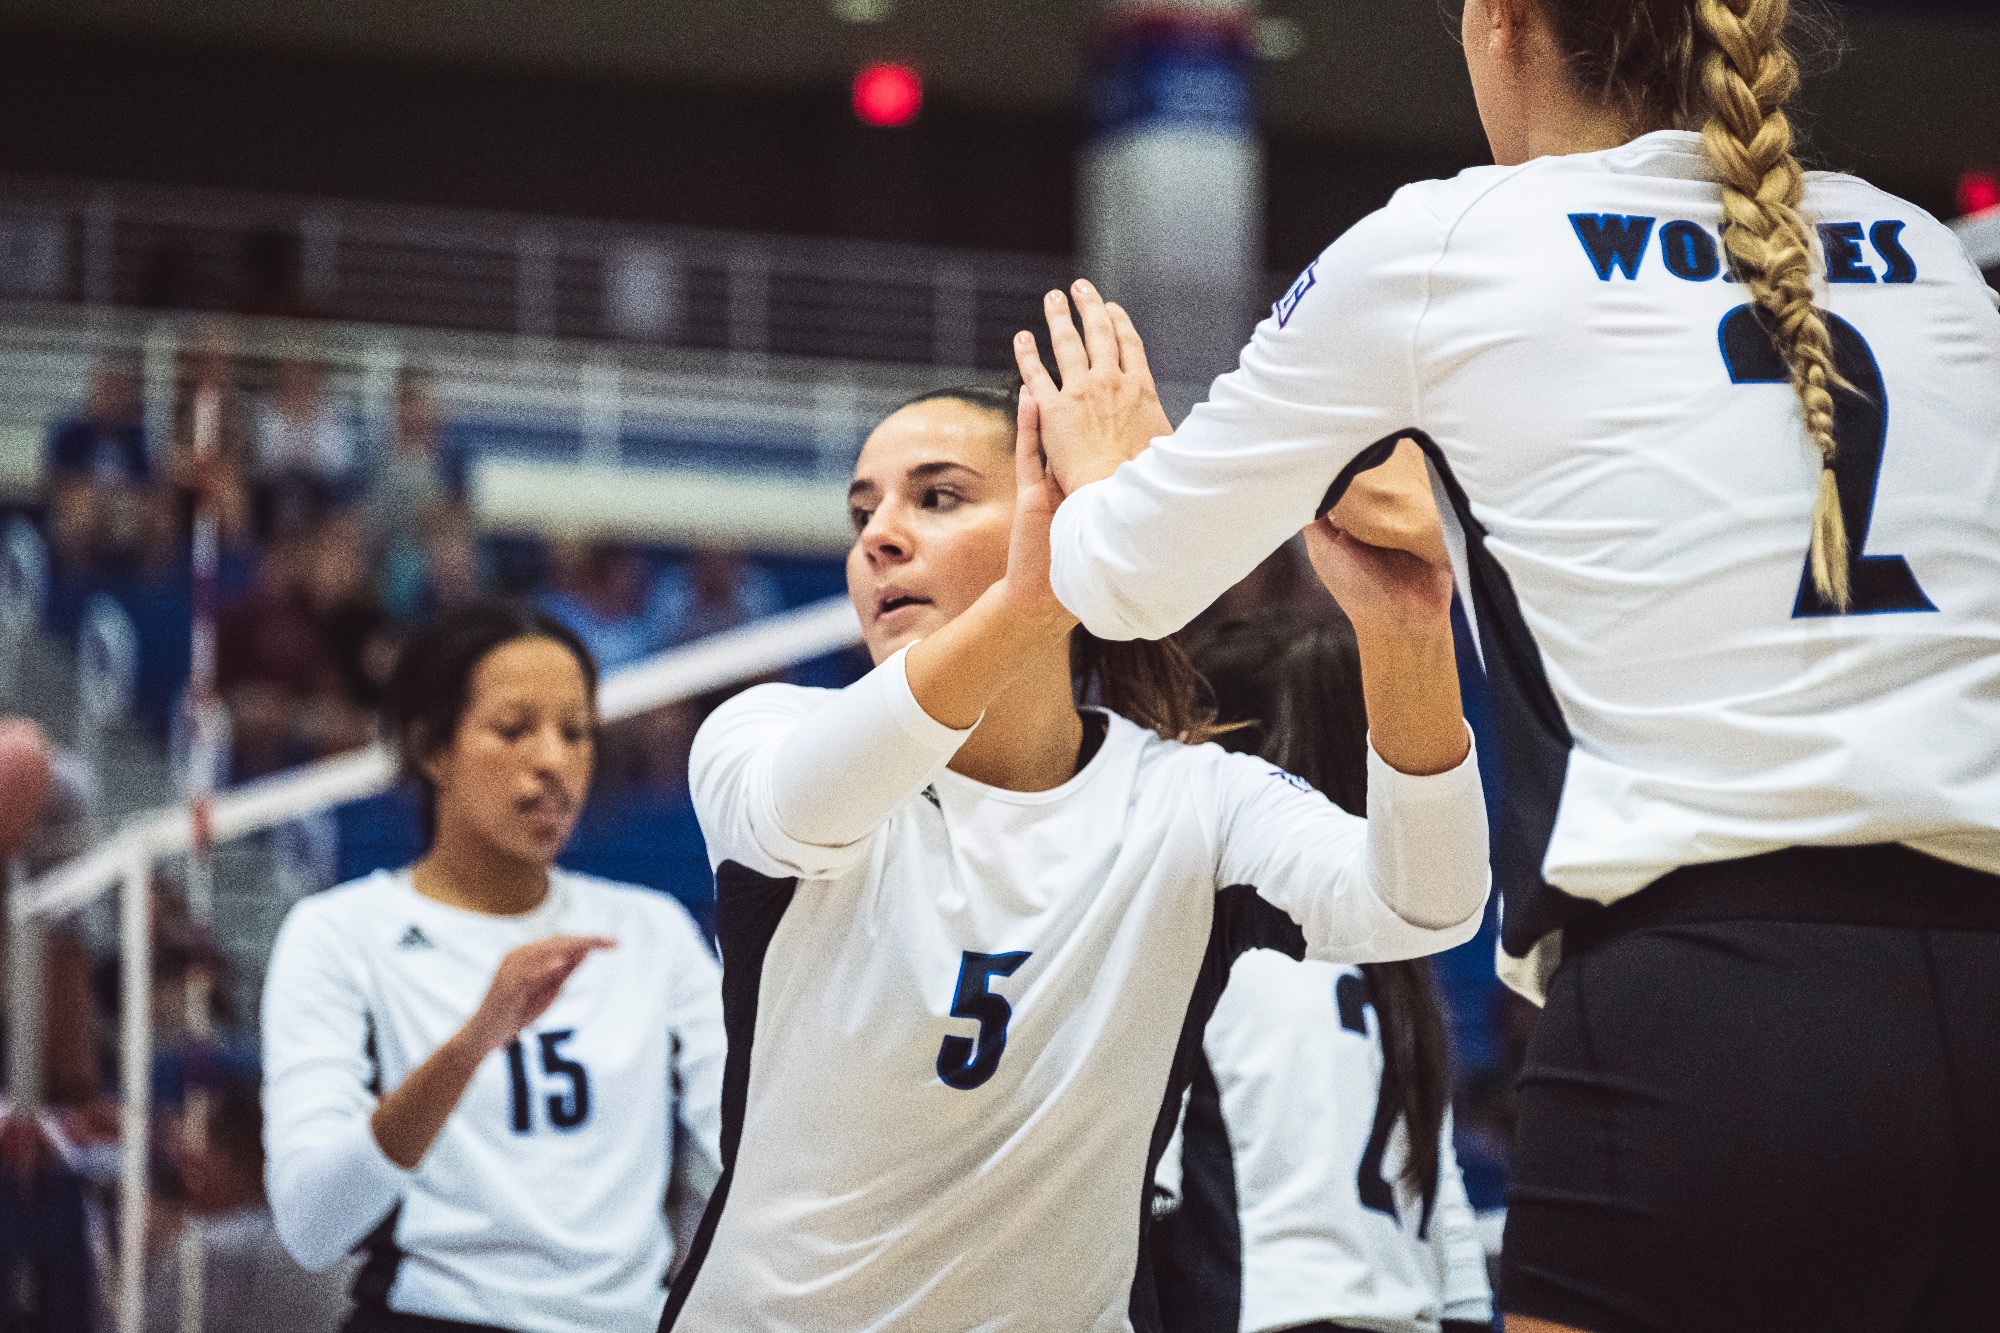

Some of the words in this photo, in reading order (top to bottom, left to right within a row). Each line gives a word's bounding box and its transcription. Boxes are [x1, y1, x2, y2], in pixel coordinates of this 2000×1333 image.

[1567, 213, 1918, 284] WOES
[1717, 302, 1941, 619] 2
[505, 1027, 593, 1135] 15
[936, 950, 1033, 1091] 5
